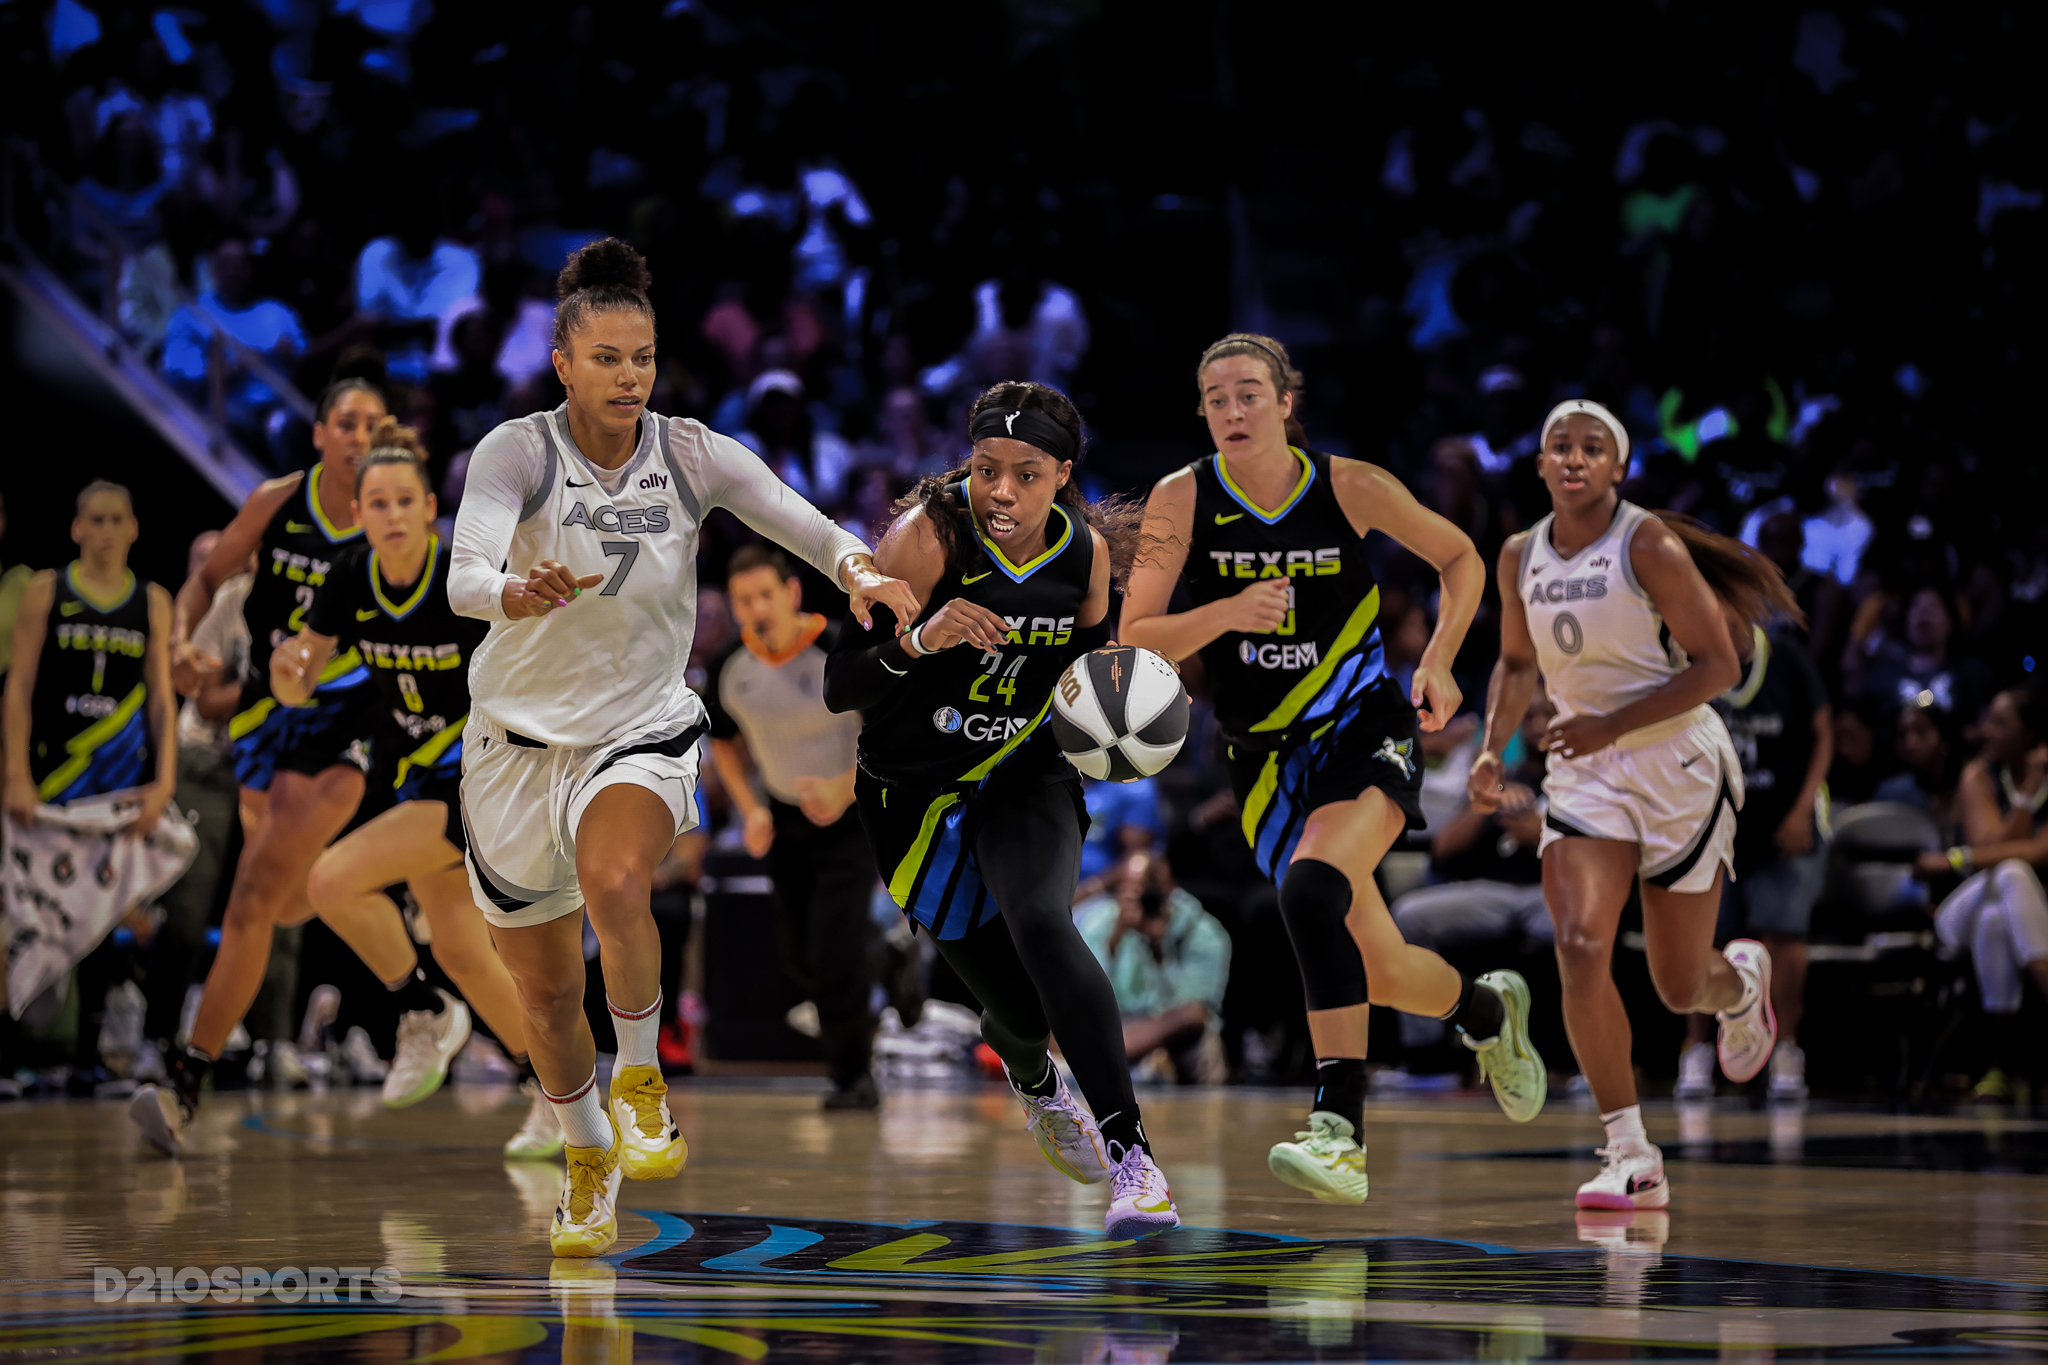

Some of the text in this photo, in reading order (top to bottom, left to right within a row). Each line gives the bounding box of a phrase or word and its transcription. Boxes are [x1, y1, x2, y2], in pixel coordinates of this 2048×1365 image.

[640, 473, 668, 490] ally
[562, 501, 671, 534] ACES
[272, 547, 332, 587] TEX
[599, 541, 640, 597] 7
[1209, 547, 1342, 579] TEXAS
[1530, 574, 1608, 606] ACES
[56, 623, 145, 658] TEXAS
[1003, 615, 1075, 646] XAS
[1553, 611, 1584, 656] 0
[359, 639, 461, 671] TEXAS
[1257, 641, 1319, 670] GEM
[397, 672, 424, 713] 0
[968, 651, 1028, 706] 24
